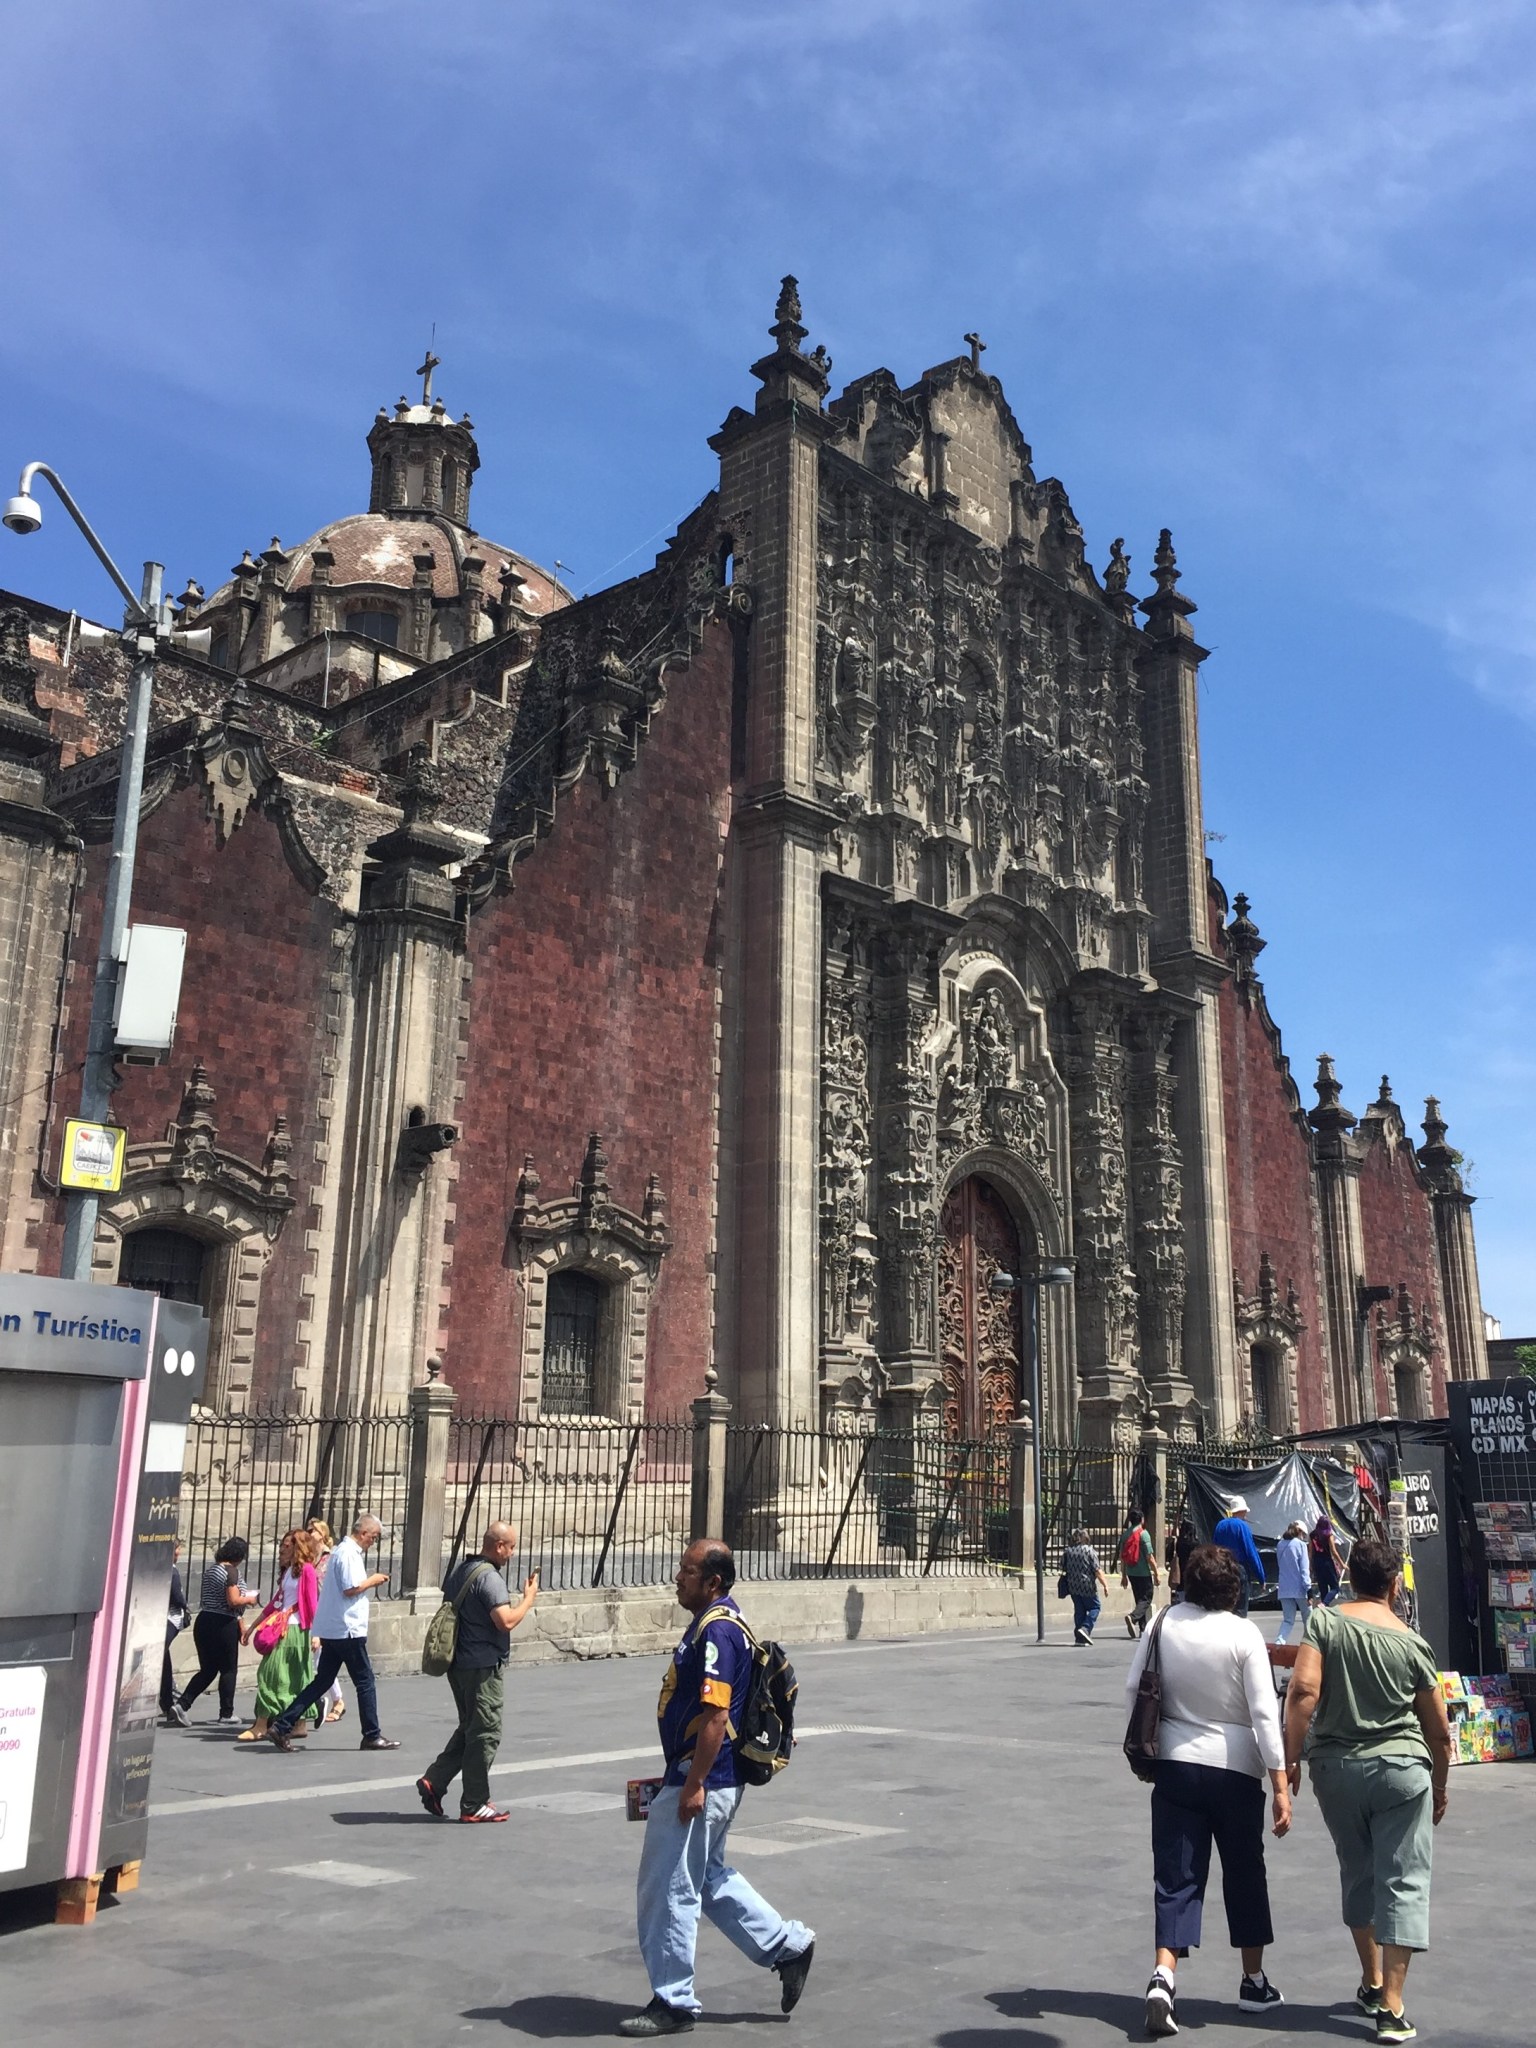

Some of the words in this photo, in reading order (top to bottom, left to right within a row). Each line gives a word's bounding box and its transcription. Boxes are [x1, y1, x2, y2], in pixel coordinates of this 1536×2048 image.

[33, 1310, 141, 1344] Turística
[1470, 1396, 1515, 1414] MAPAS
[1517, 1400, 1523, 1414] Y
[1470, 1415, 1525, 1434] PLANOS
[1414, 1495, 1429, 1512] DE
[1407, 1513, 1439, 1534] TEXTO
[0, 1706, 36, 1718] Gratuita
